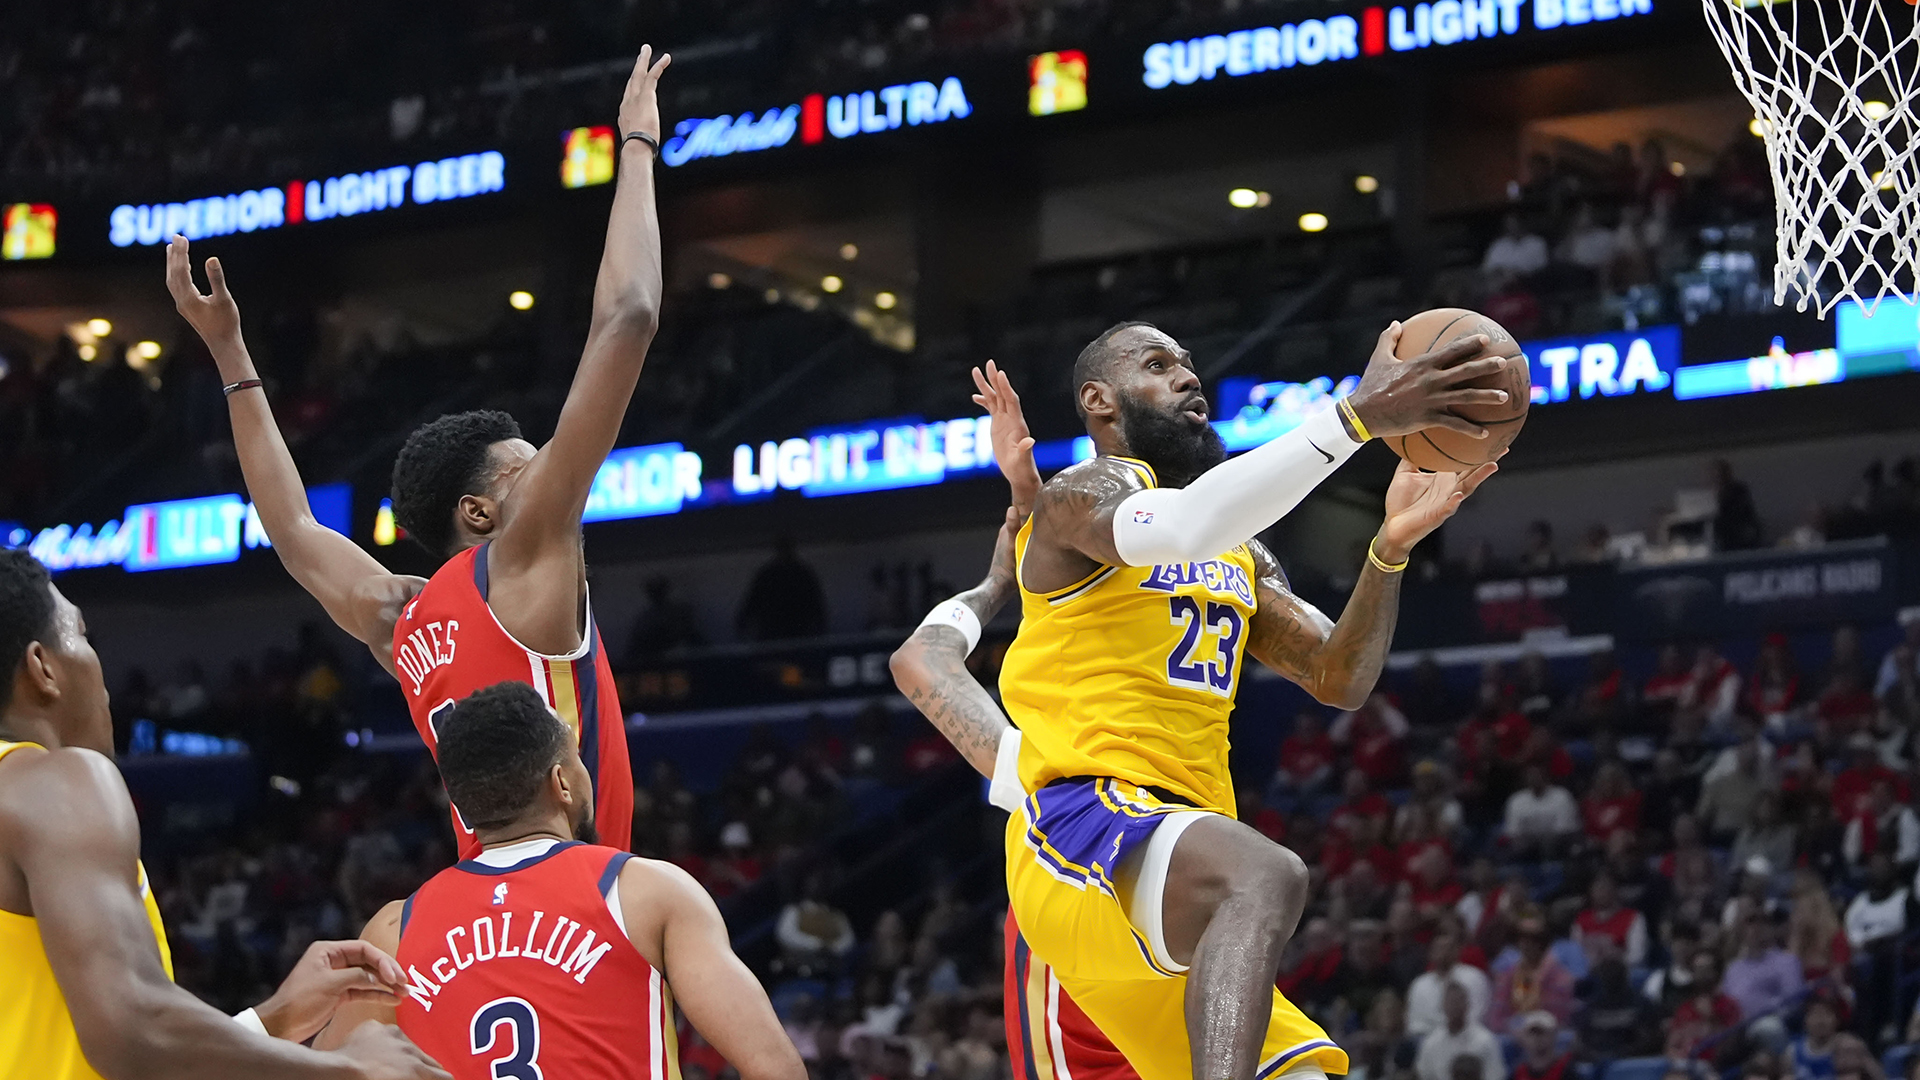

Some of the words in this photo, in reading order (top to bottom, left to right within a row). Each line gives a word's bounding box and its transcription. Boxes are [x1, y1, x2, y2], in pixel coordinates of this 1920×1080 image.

[1142, 13, 1359, 90] SUPERIOR
[1388, 0, 1526, 52] LIGHT
[826, 76, 974, 139] ULTRA
[108, 187, 285, 247] SUPERIOR
[304, 165, 411, 221] LIGHT
[412, 150, 505, 205] BEER
[732, 429, 879, 496] LIGHT
[396, 619, 460, 697] JONES
[1166, 595, 1245, 699] 23
[403, 910, 613, 1013] McCOLLUM
[469, 995, 545, 1080] 3
